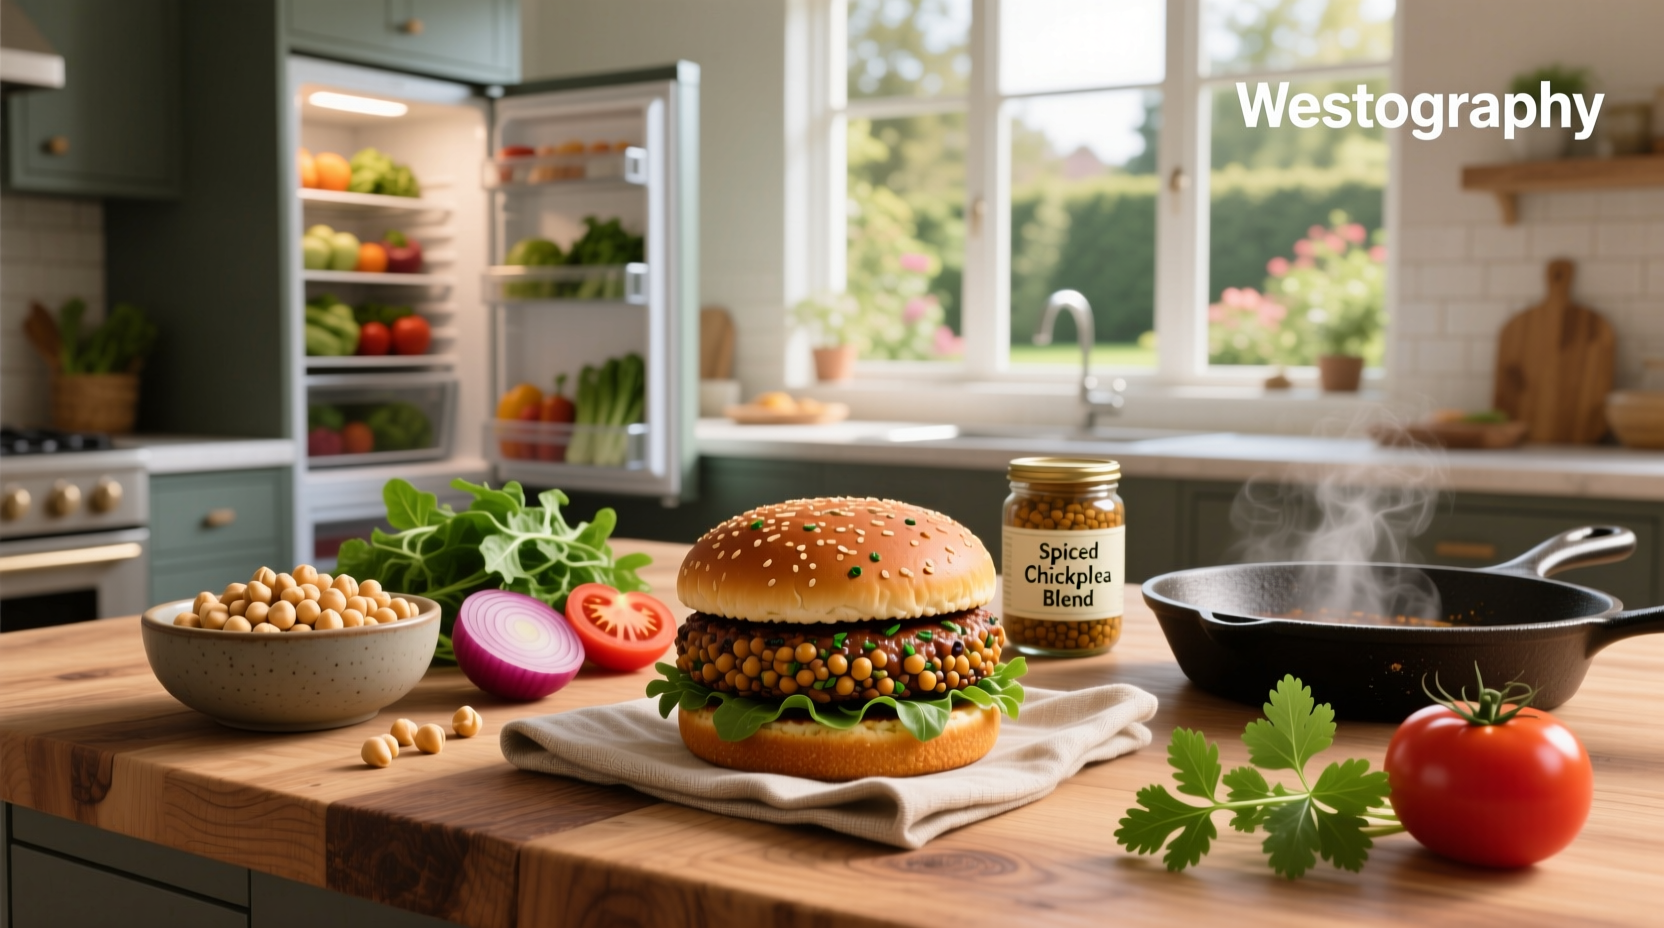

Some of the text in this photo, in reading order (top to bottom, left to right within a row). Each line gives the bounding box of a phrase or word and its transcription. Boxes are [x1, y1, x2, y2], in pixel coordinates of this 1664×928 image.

[1039, 541, 1099, 565] Spiced
[1024, 564, 1112, 590] Chickplea
[1043, 589, 1094, 607] Blend
